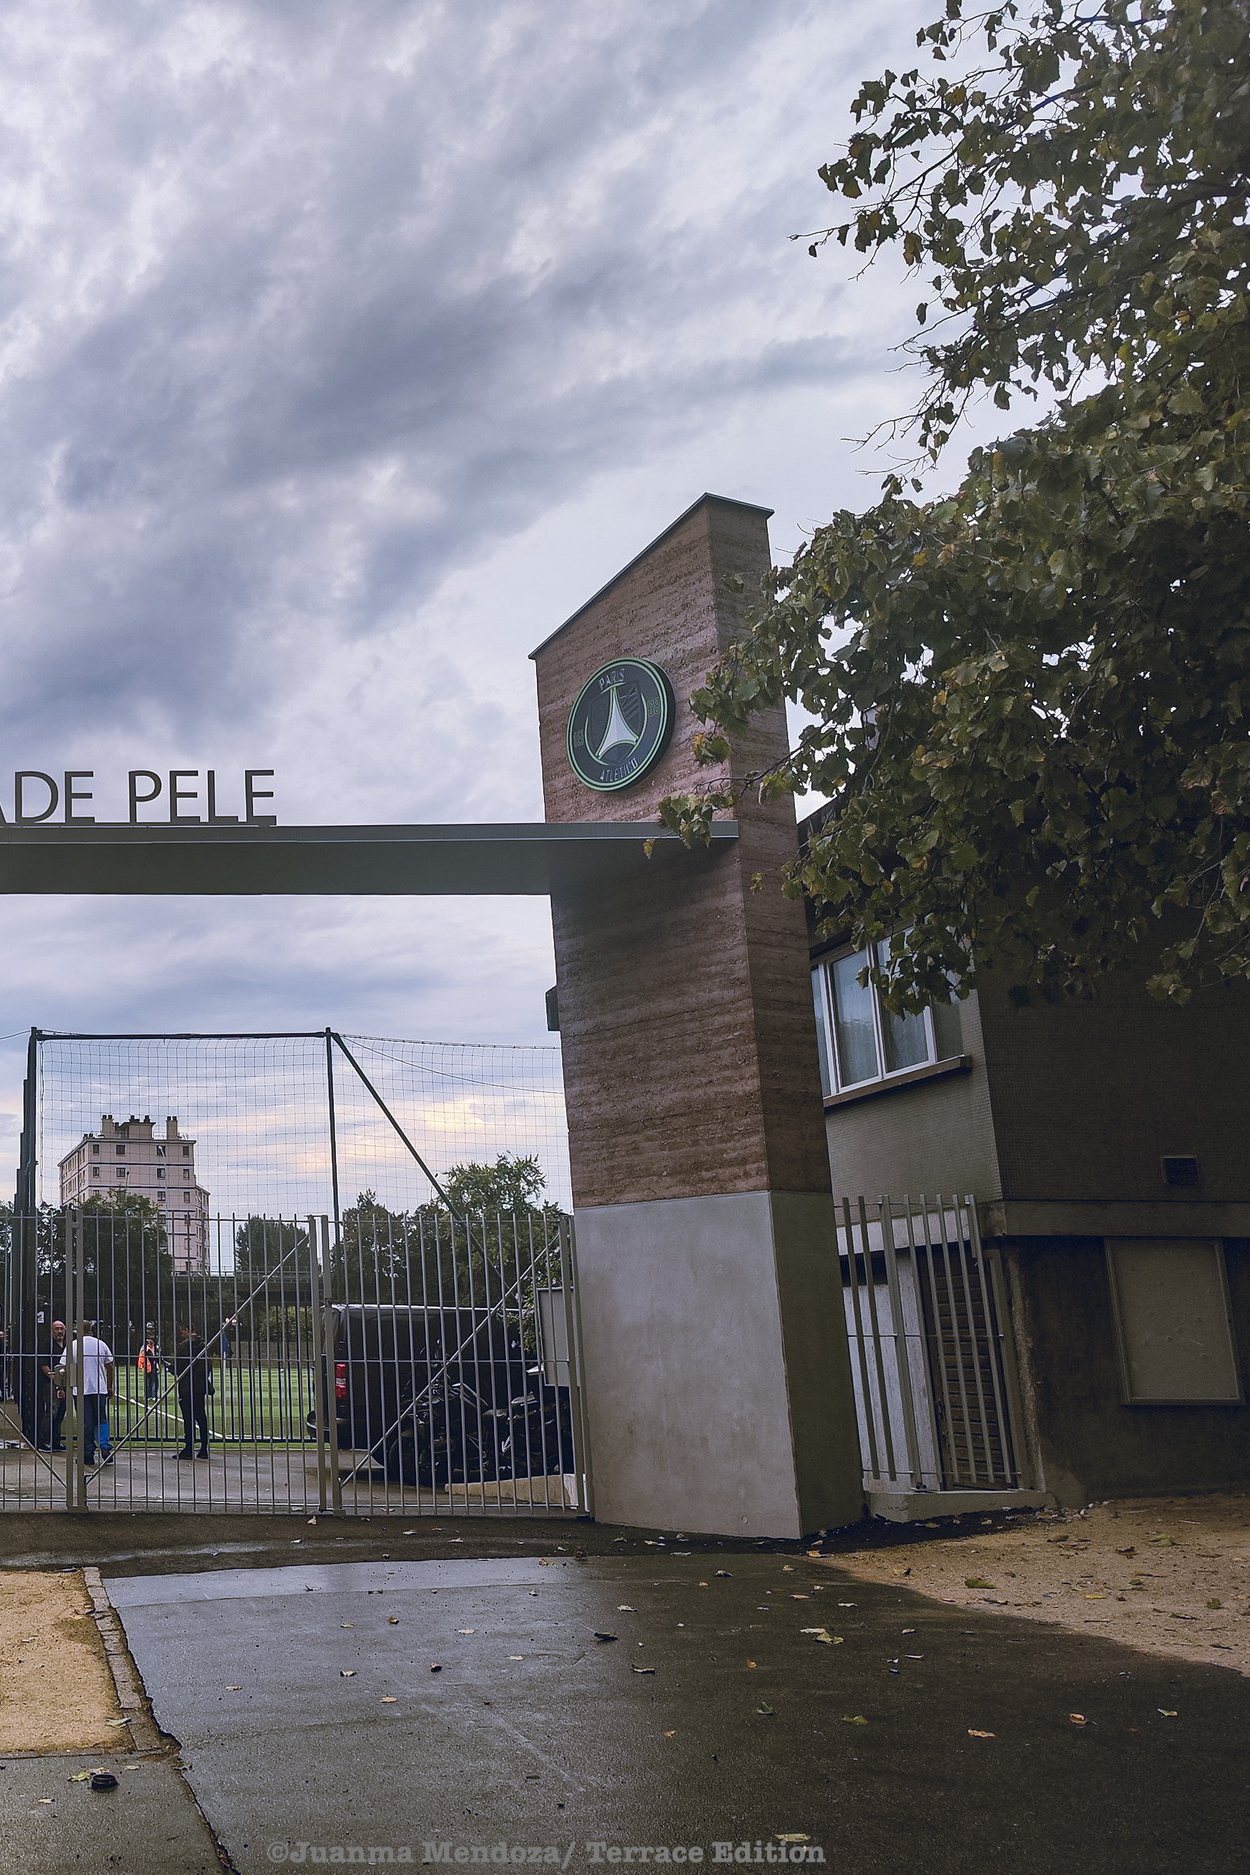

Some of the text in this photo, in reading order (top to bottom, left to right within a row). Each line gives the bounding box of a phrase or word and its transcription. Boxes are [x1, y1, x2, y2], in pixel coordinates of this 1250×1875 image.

[599, 668, 625, 690] PARIS
[599, 757, 639, 782] ATLETICO
[128, 769, 277, 825] PELE
